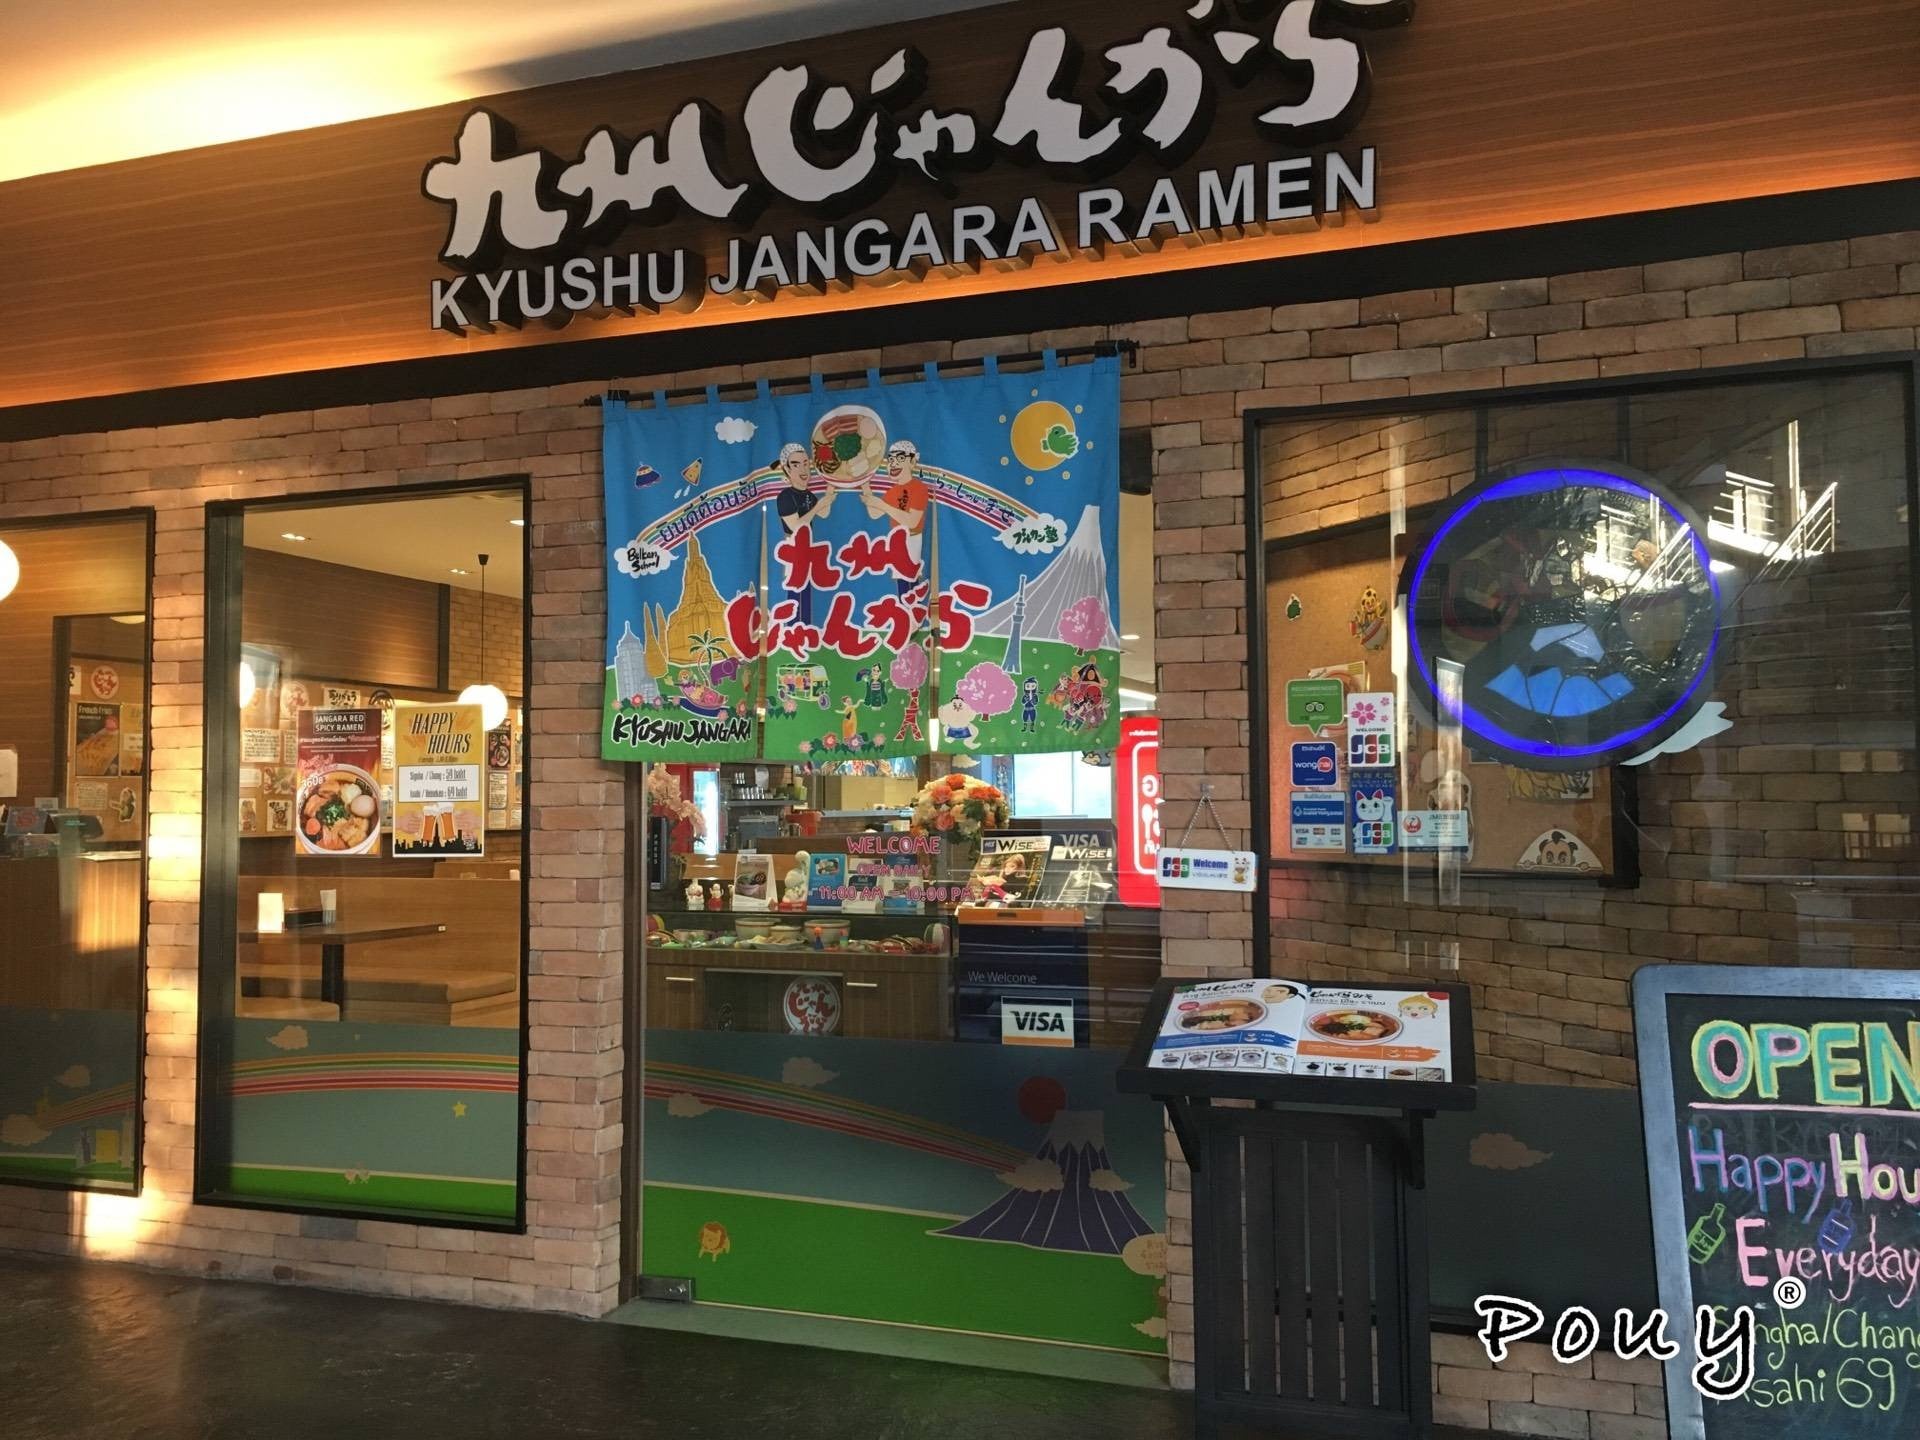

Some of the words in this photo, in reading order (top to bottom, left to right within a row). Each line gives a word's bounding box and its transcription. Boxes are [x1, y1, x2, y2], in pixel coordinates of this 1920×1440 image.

[430, 249, 684, 330] KYUSHU
[709, 197, 1059, 294] JANGARA
[1078, 147, 1376, 249] RAMEN
[656, 481, 758, 543] ยินดีต้อนรับ
[776, 526, 922, 590] 九州
[727, 580, 991, 660] じゃんがら
[315, 715, 348, 723] JANGARA
[350, 714, 364, 722] RED
[315, 724, 335, 732] SPICY
[411, 712, 457, 734] HAPPY
[613, 714, 684, 747] KYUSHU
[427, 733, 472, 754] HOURS
[846, 836, 941, 854] WELCOME
[1061, 833, 1100, 848] VISA
[856, 864, 891, 877] OPEN
[1193, 858, 1229, 869] Welcome
[818, 885, 858, 900] 11:00
[859, 886, 885, 900] AM
[904, 885, 948, 901] 10:00
[950, 885, 976, 900] PM
[968, 970, 985, 982] We
[986, 971, 1038, 984] Welcome
[1010, 1010, 1066, 1032] VISA
[1690, 1019, 1920, 1110] OPEN
[1688, 1125, 1827, 1224] Happy
[1736, 1216, 1920, 1308] Everyday
[1837, 1357, 1896, 1411] 69
